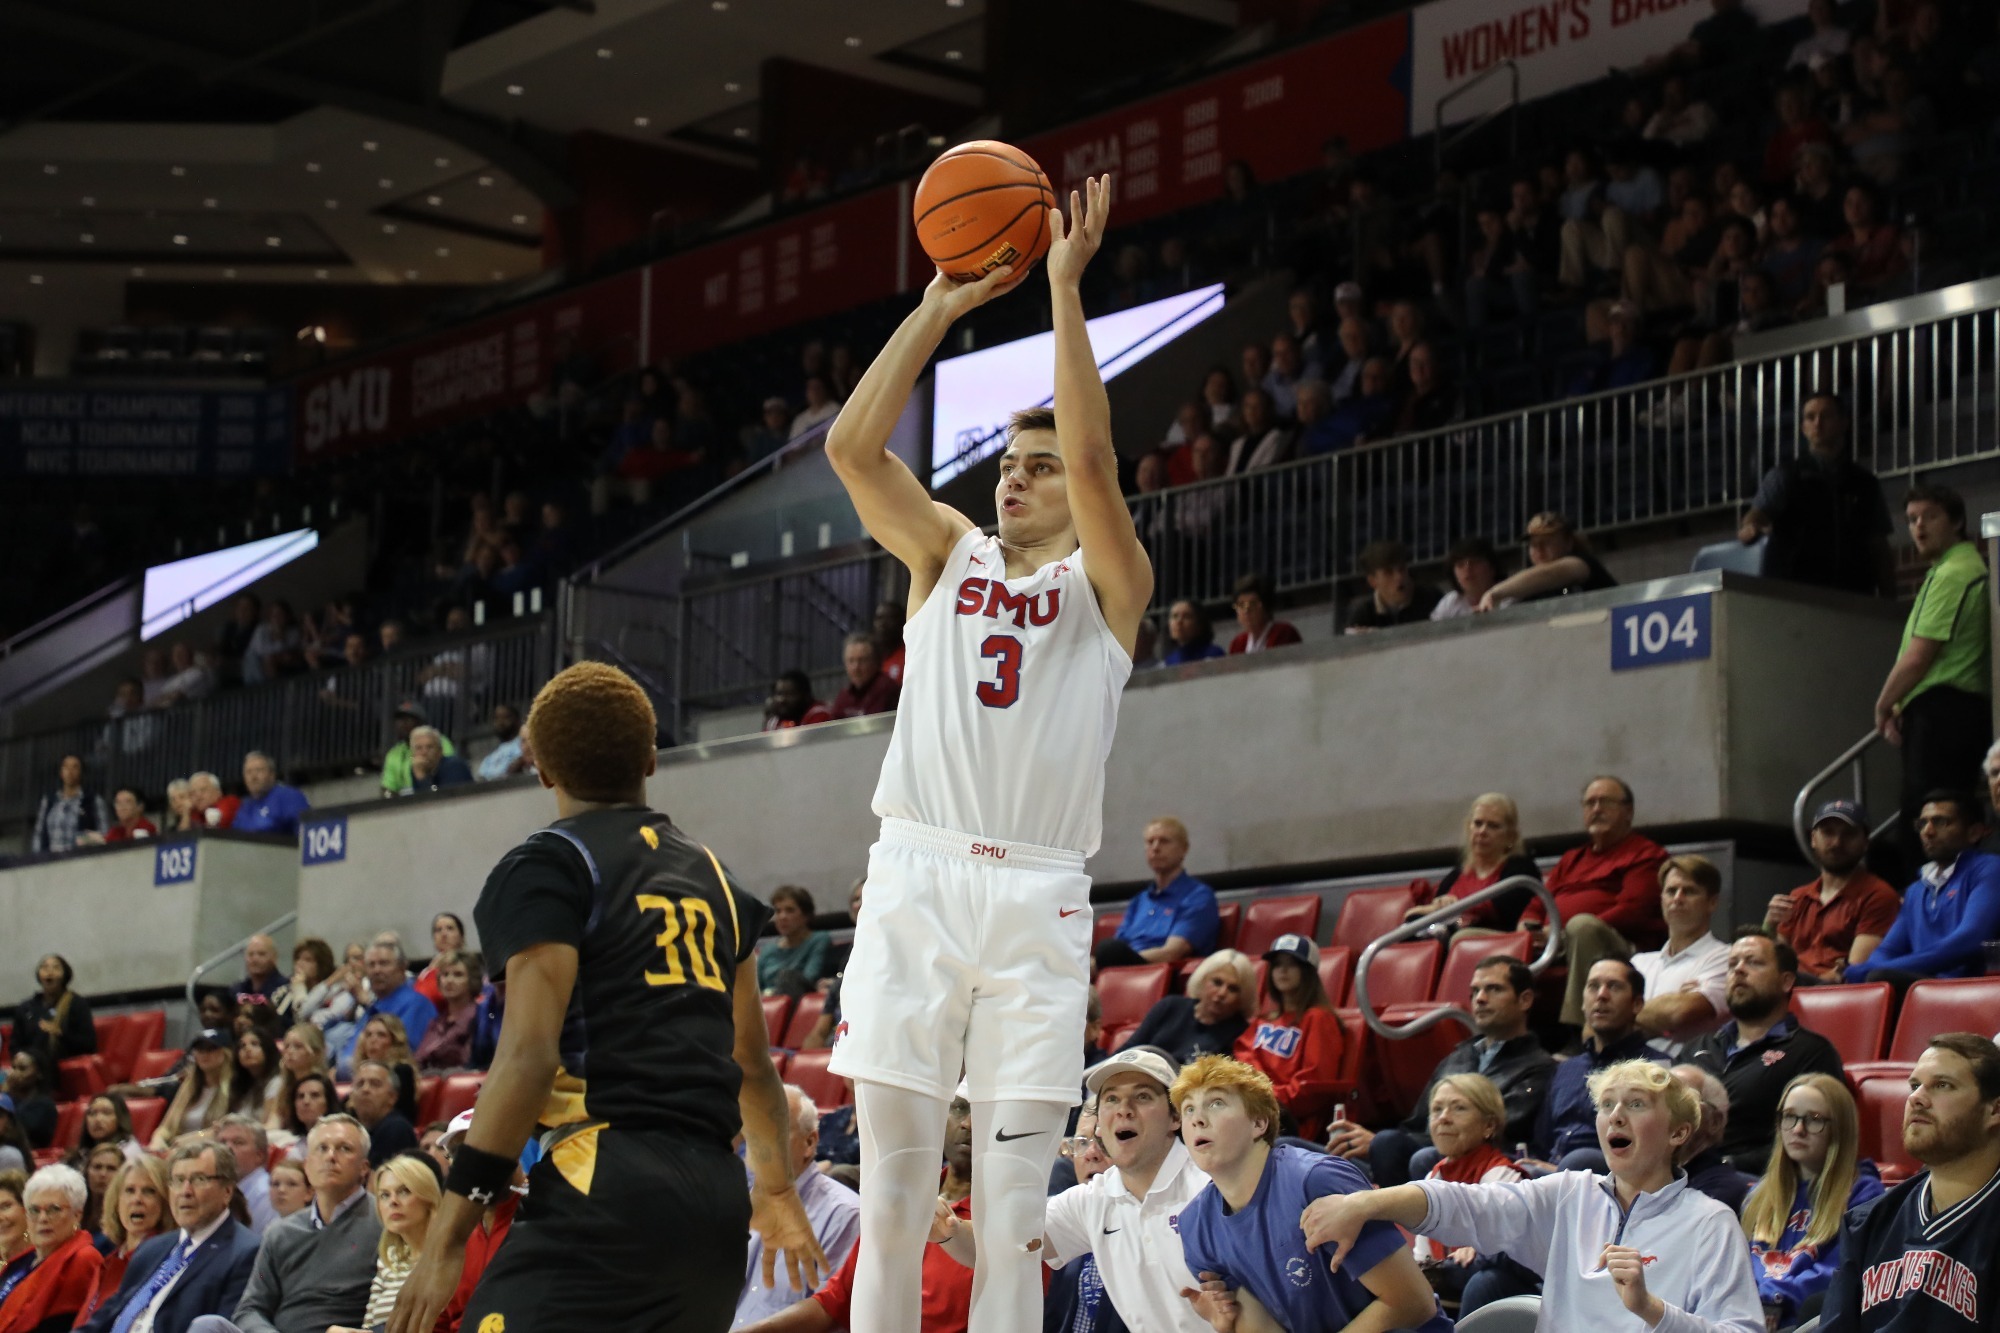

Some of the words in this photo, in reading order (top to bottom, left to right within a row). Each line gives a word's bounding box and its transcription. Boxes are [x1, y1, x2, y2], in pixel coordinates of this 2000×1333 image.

[1442, 0, 1589, 79] WOMEN'S
[304, 364, 392, 454] SMU
[956, 577, 1061, 630] SMU
[1624, 606, 1699, 657] 104
[976, 634, 1024, 709] 3
[160, 846, 193, 879] 103
[307, 823, 342, 858] 104
[970, 843, 1007, 859] SMU
[636, 894, 726, 993] 30
[1862, 1259, 1904, 1315] MU
